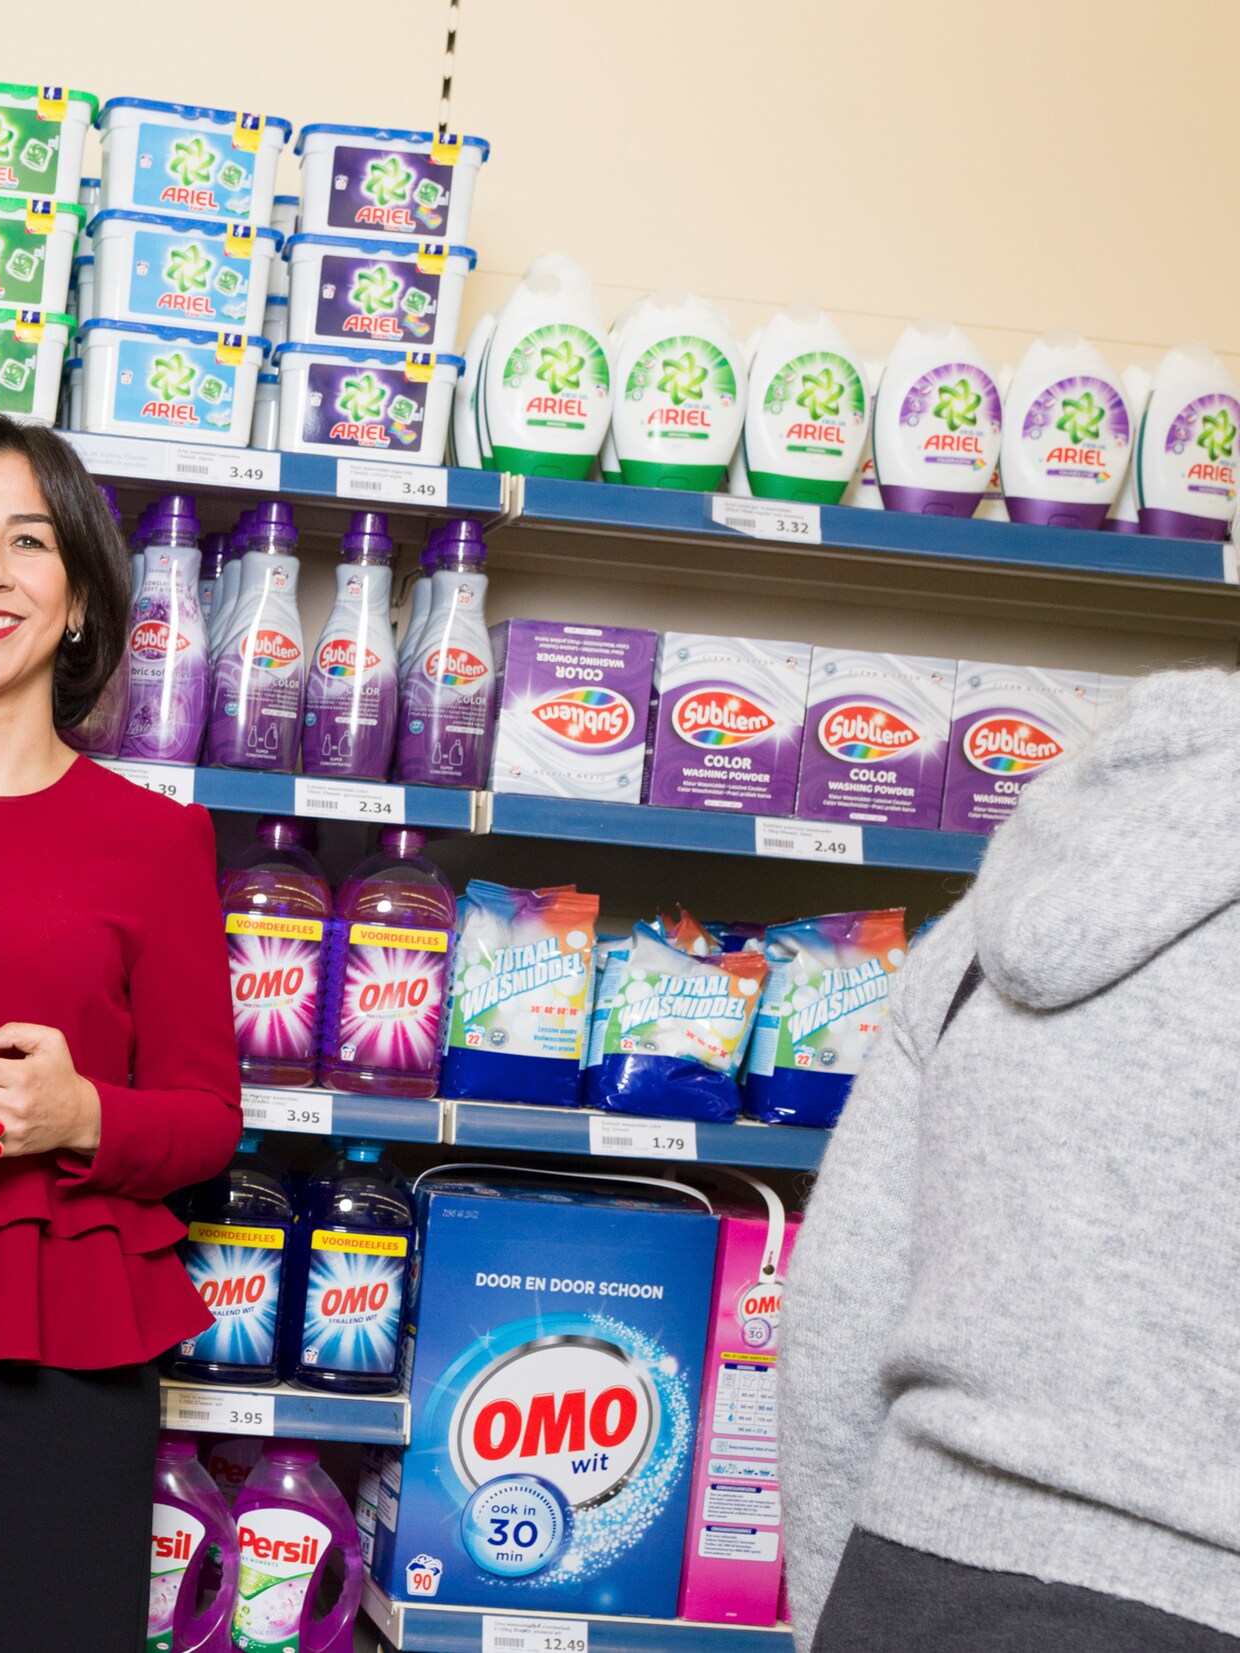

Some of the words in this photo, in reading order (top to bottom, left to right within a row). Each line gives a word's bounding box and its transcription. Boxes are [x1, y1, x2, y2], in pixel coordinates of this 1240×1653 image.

[160, 186, 218, 208] ARIEL
[355, 206, 415, 226] ARIEL
[157, 293, 215, 314] ARIEL
[343, 315, 403, 335] ARIEL
[142, 402, 199, 422] ARIEL
[526, 397, 587, 417] ARIEL
[647, 408, 711, 427] ARIEL
[330, 423, 390, 442] ARIEL
[786, 423, 845, 443] ARIEL
[923, 434, 983, 454] ARIEL
[1046, 447, 1106, 467] ARIEL
[229, 467, 264, 480] 3.49
[1187, 463, 1235, 484] ARIEL
[402, 482, 436, 496] 3.49
[776, 519, 809, 534] 3.32
[349, 586, 360, 595] 20
[536, 652, 577, 665] POWDER
[579, 656, 624, 668] WASHING
[556, 665, 603, 681] COLOR
[540, 704, 624, 735] Subliem
[683, 701, 769, 731] Subliem
[829, 715, 913, 745] Subliem
[973, 728, 1057, 758] Subliem
[704, 755, 751, 770] COLOR
[682, 768, 727, 781] WASHING
[729, 771, 770, 783] POWDER
[849, 768, 896, 783] COLOR
[828, 781, 873, 794] WASHING
[874, 784, 914, 797] POWDER
[359, 801, 392, 815] 2.34
[814, 841, 846, 855] 2.49
[236, 920, 314, 935] VOORDEELFLES
[361, 930, 439, 946] VOORDEELFLES
[493, 937, 558, 976] TOTAAL
[235, 966, 304, 1002] OMO
[657, 974, 730, 997] TOTAAL
[820, 958, 885, 997] TOTAAL
[359, 978, 429, 1013] OMO
[460, 952, 585, 1024] WASMIDDEL
[620, 995, 747, 1033] WASMIDDEL
[468, 1033, 479, 1044] 22
[797, 1054, 809, 1065] 22
[287, 1110, 320, 1123] 3.95
[652, 1136, 684, 1150] 1.79
[199, 1228, 275, 1243] VOORDEELFLES
[322, 1236, 398, 1251] VOORDEELFLES
[476, 1272, 521, 1289] DOOR
[525, 1276, 546, 1291] EN
[550, 1278, 595, 1295] DOOR
[599, 1281, 664, 1299] SCHOON
[321, 1282, 388, 1316] OMO
[329, 1316, 363, 1325] STRALEND
[365, 1314, 377, 1322] WIT
[748, 1328, 763, 1340] 30
[306, 1353, 315, 1362] 27
[229, 1411, 262, 1424] 3.95
[473, 1384, 638, 1462] OMO
[571, 1453, 609, 1475] wit
[491, 1503, 518, 1516] ook
[521, 1504, 536, 1516] in
[487, 1519, 538, 1547] 30
[239, 1526, 318, 1565] Persil
[495, 1549, 523, 1563] min
[413, 1573, 431, 1591] 90
[544, 1638, 585, 1652] 12.49
